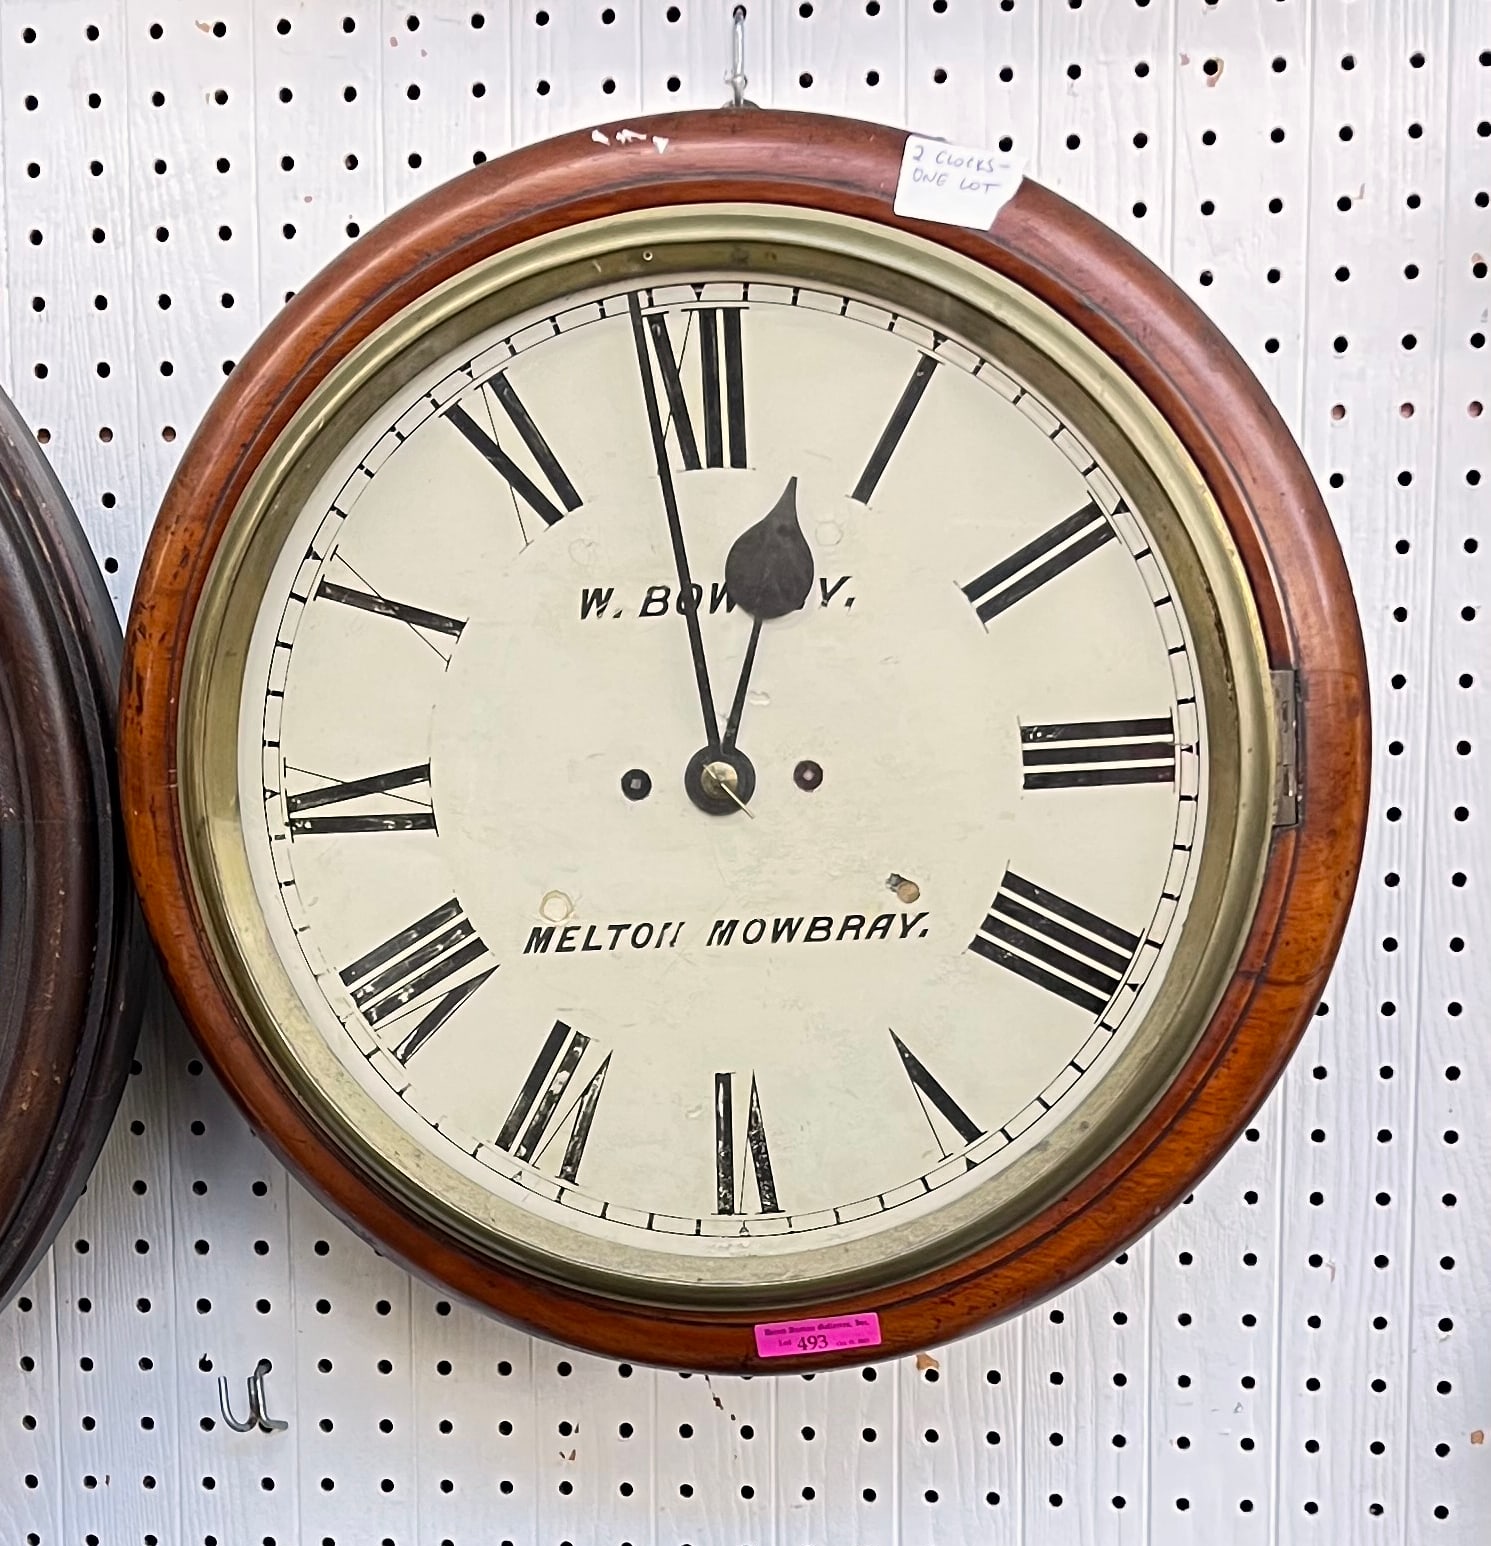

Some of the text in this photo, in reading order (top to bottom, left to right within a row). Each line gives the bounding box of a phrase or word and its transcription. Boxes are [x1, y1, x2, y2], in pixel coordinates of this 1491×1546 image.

[912, 145, 924, 161] 2
[912, 168, 1001, 194] ONE LOT
[438, 366, 584, 554] XI
[954, 490, 1122, 633] II
[1017, 707, 1175, 795] III
[706, 912, 930, 947] MOWBRAY.
[962, 860, 1145, 1024] IIII
[797, 1334, 829, 1351] 493
